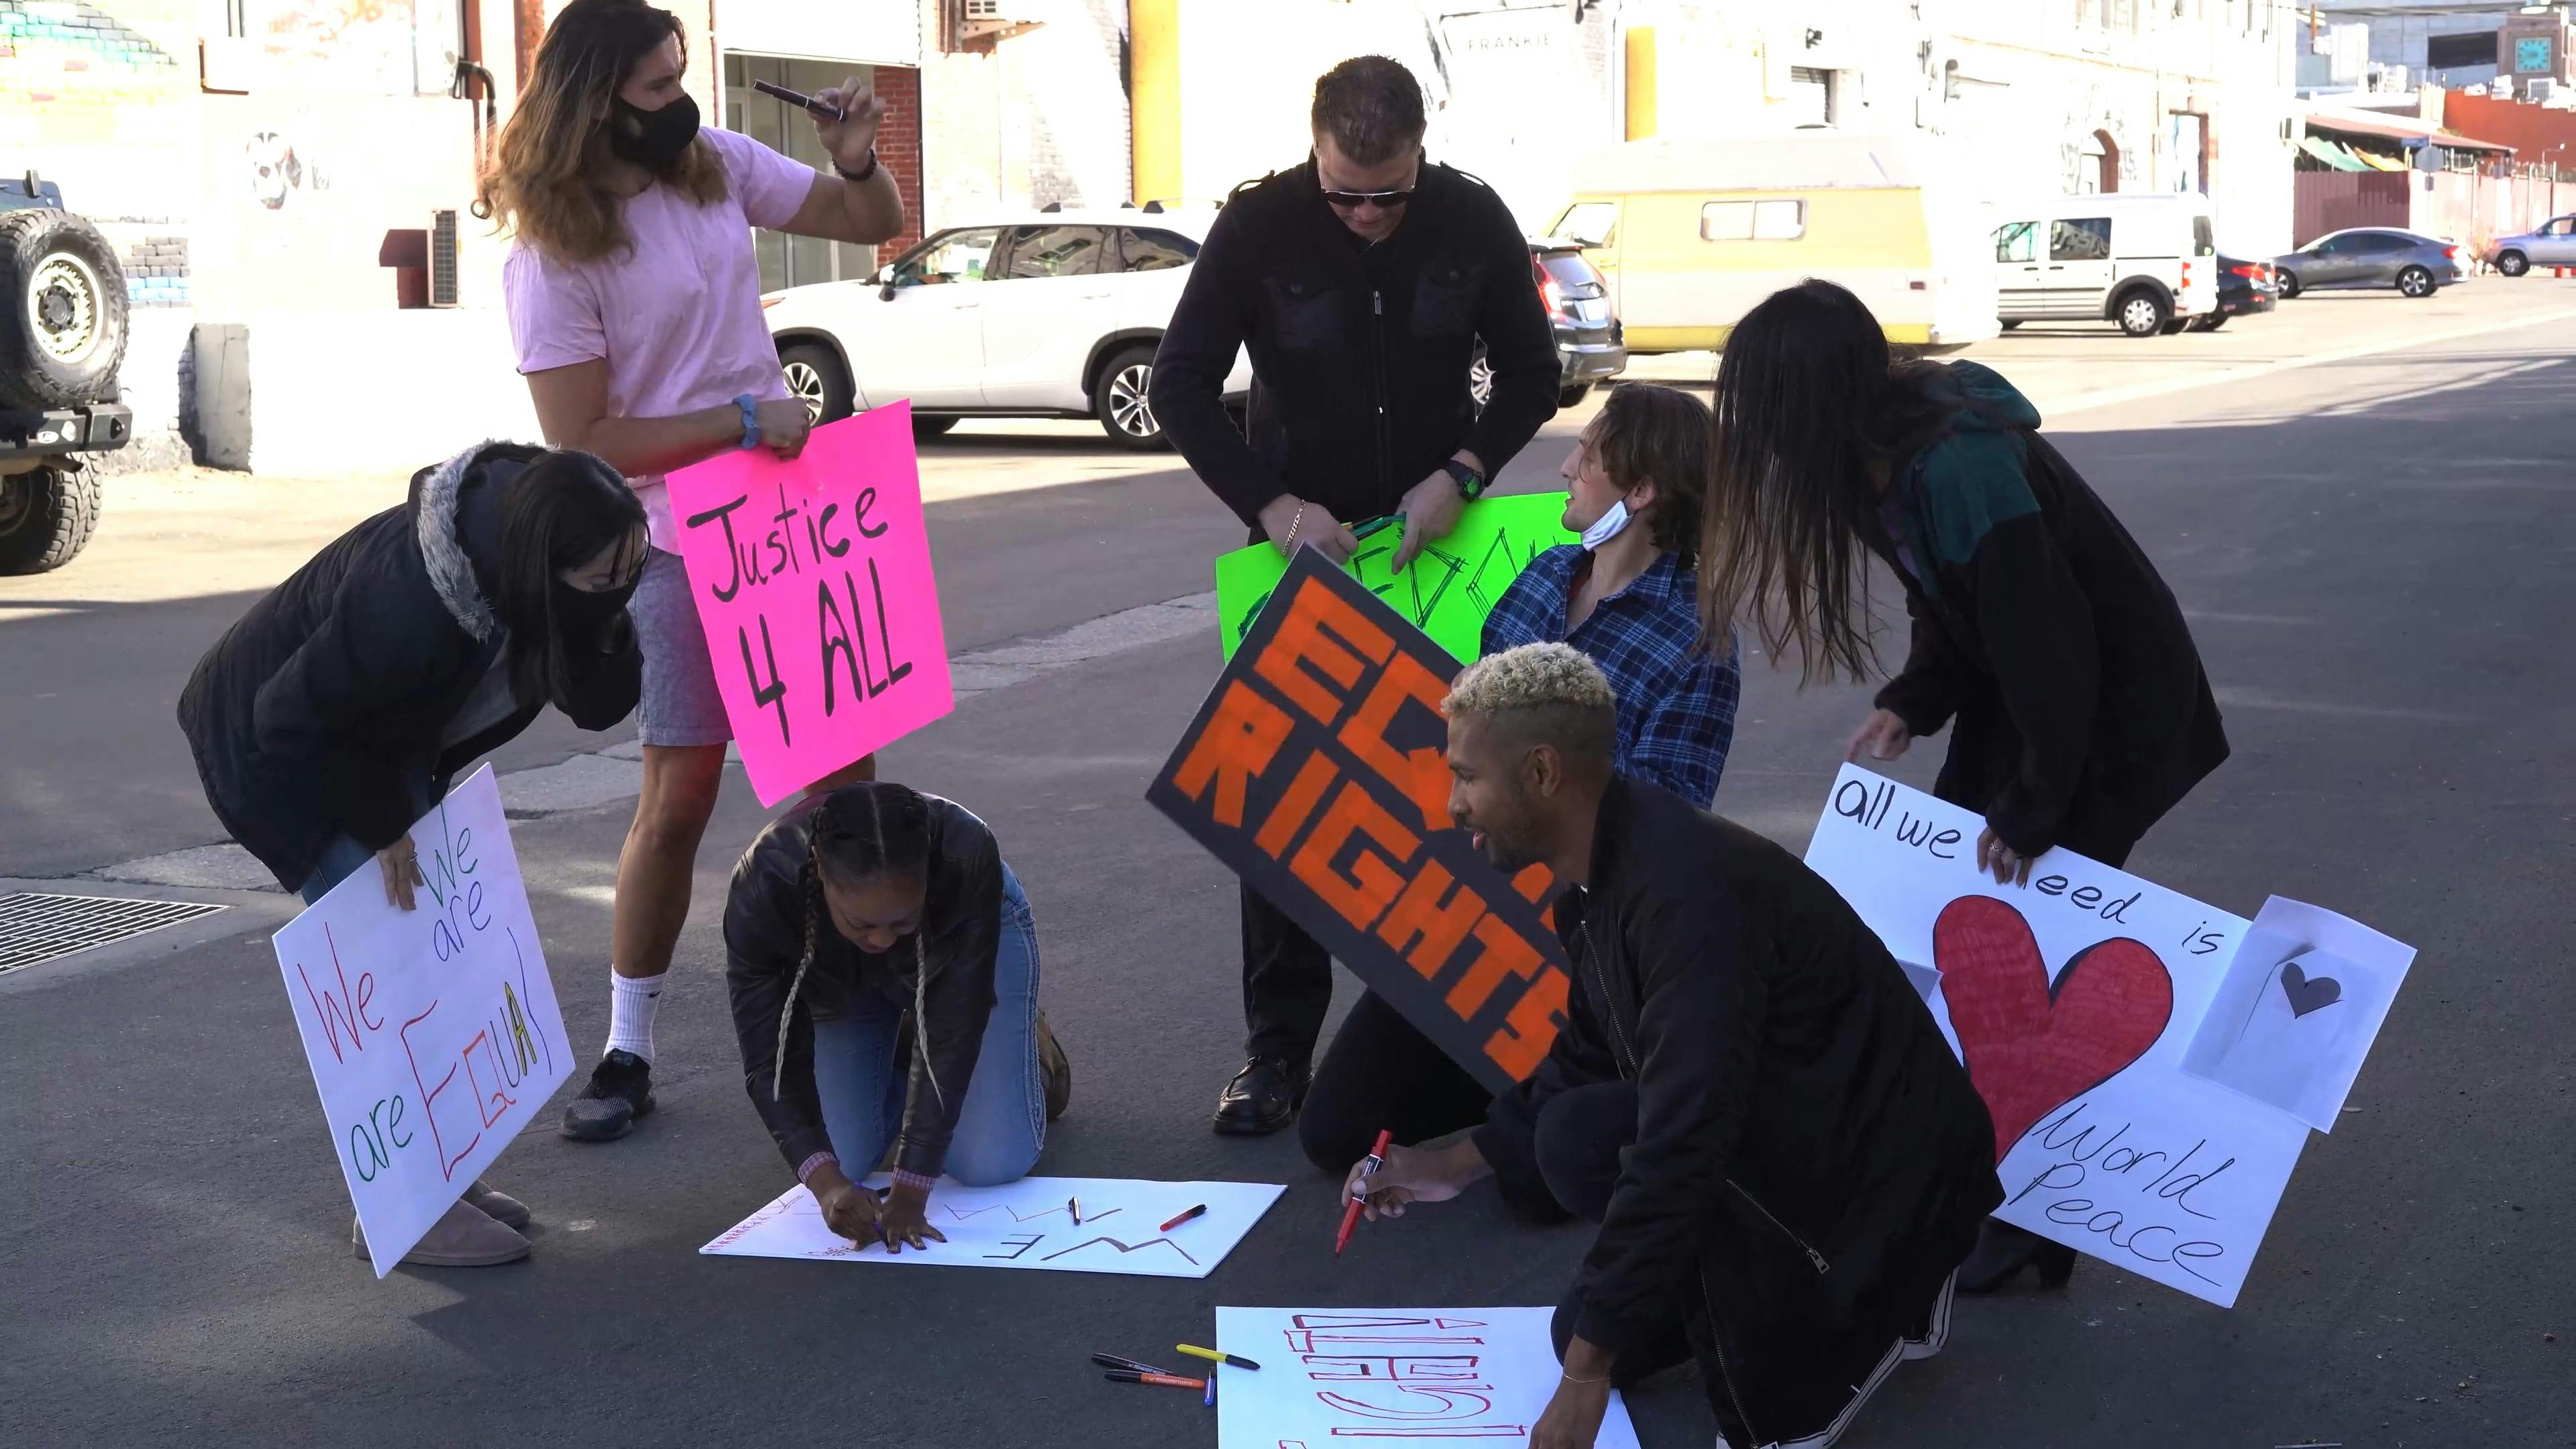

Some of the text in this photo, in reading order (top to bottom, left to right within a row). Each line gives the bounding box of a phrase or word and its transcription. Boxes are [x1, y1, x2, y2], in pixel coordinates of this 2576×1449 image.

[1468, 33, 1550, 51] FRANKIE
[686, 482, 888, 602] Justice
[739, 556, 913, 748] 4 ALL
[414, 800, 478, 908] We
[1172, 679, 1570, 1082] RIGHTS
[1835, 780, 1896, 830] all
[1896, 811, 1962, 859] we
[2182, 920, 2224, 955] is
[433, 880, 491, 961] are
[297, 921, 384, 1065] We
[350, 1094, 413, 1182] are
[2031, 1103, 2235, 1220] World
[982, 1233, 1200, 1266] WE
[2008, 1163, 2224, 1287] Peace
